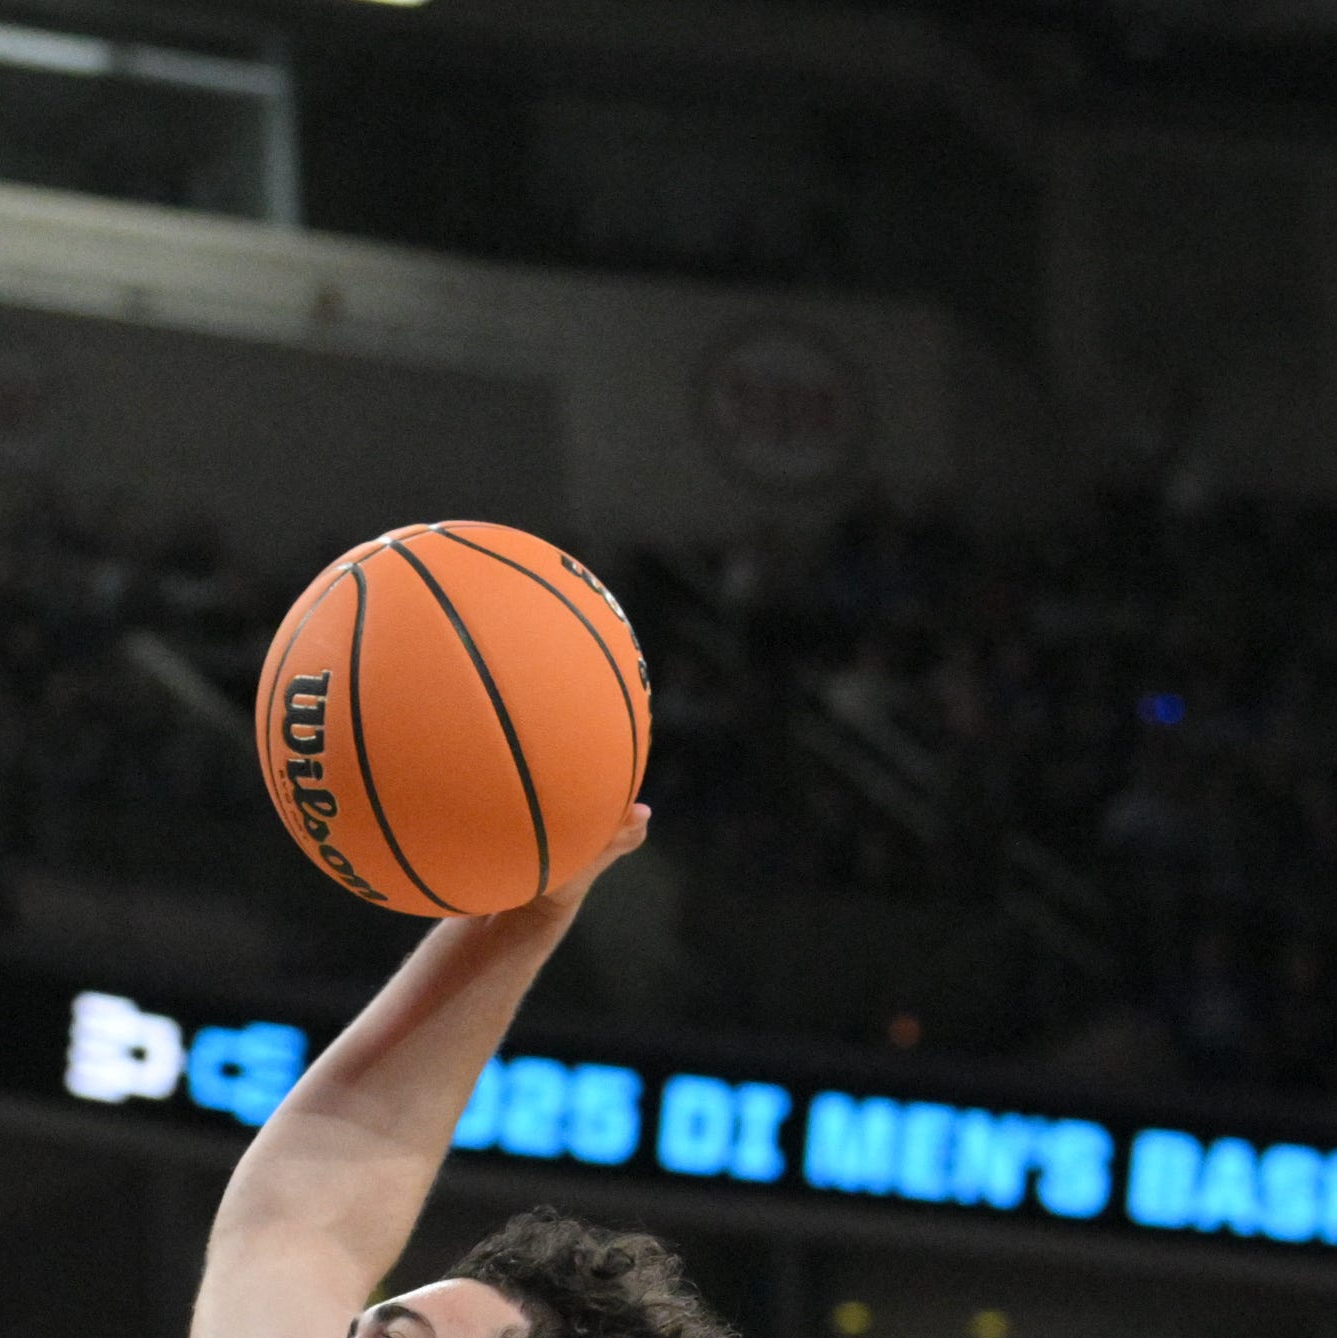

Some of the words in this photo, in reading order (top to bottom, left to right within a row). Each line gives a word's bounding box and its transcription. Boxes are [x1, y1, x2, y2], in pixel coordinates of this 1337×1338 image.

[282, 669, 388, 902] Wilson
[453, 1054, 641, 1164] 25
[802, 1090, 1115, 1220] MEN'S
[1125, 1127, 1337, 1246] BAS
